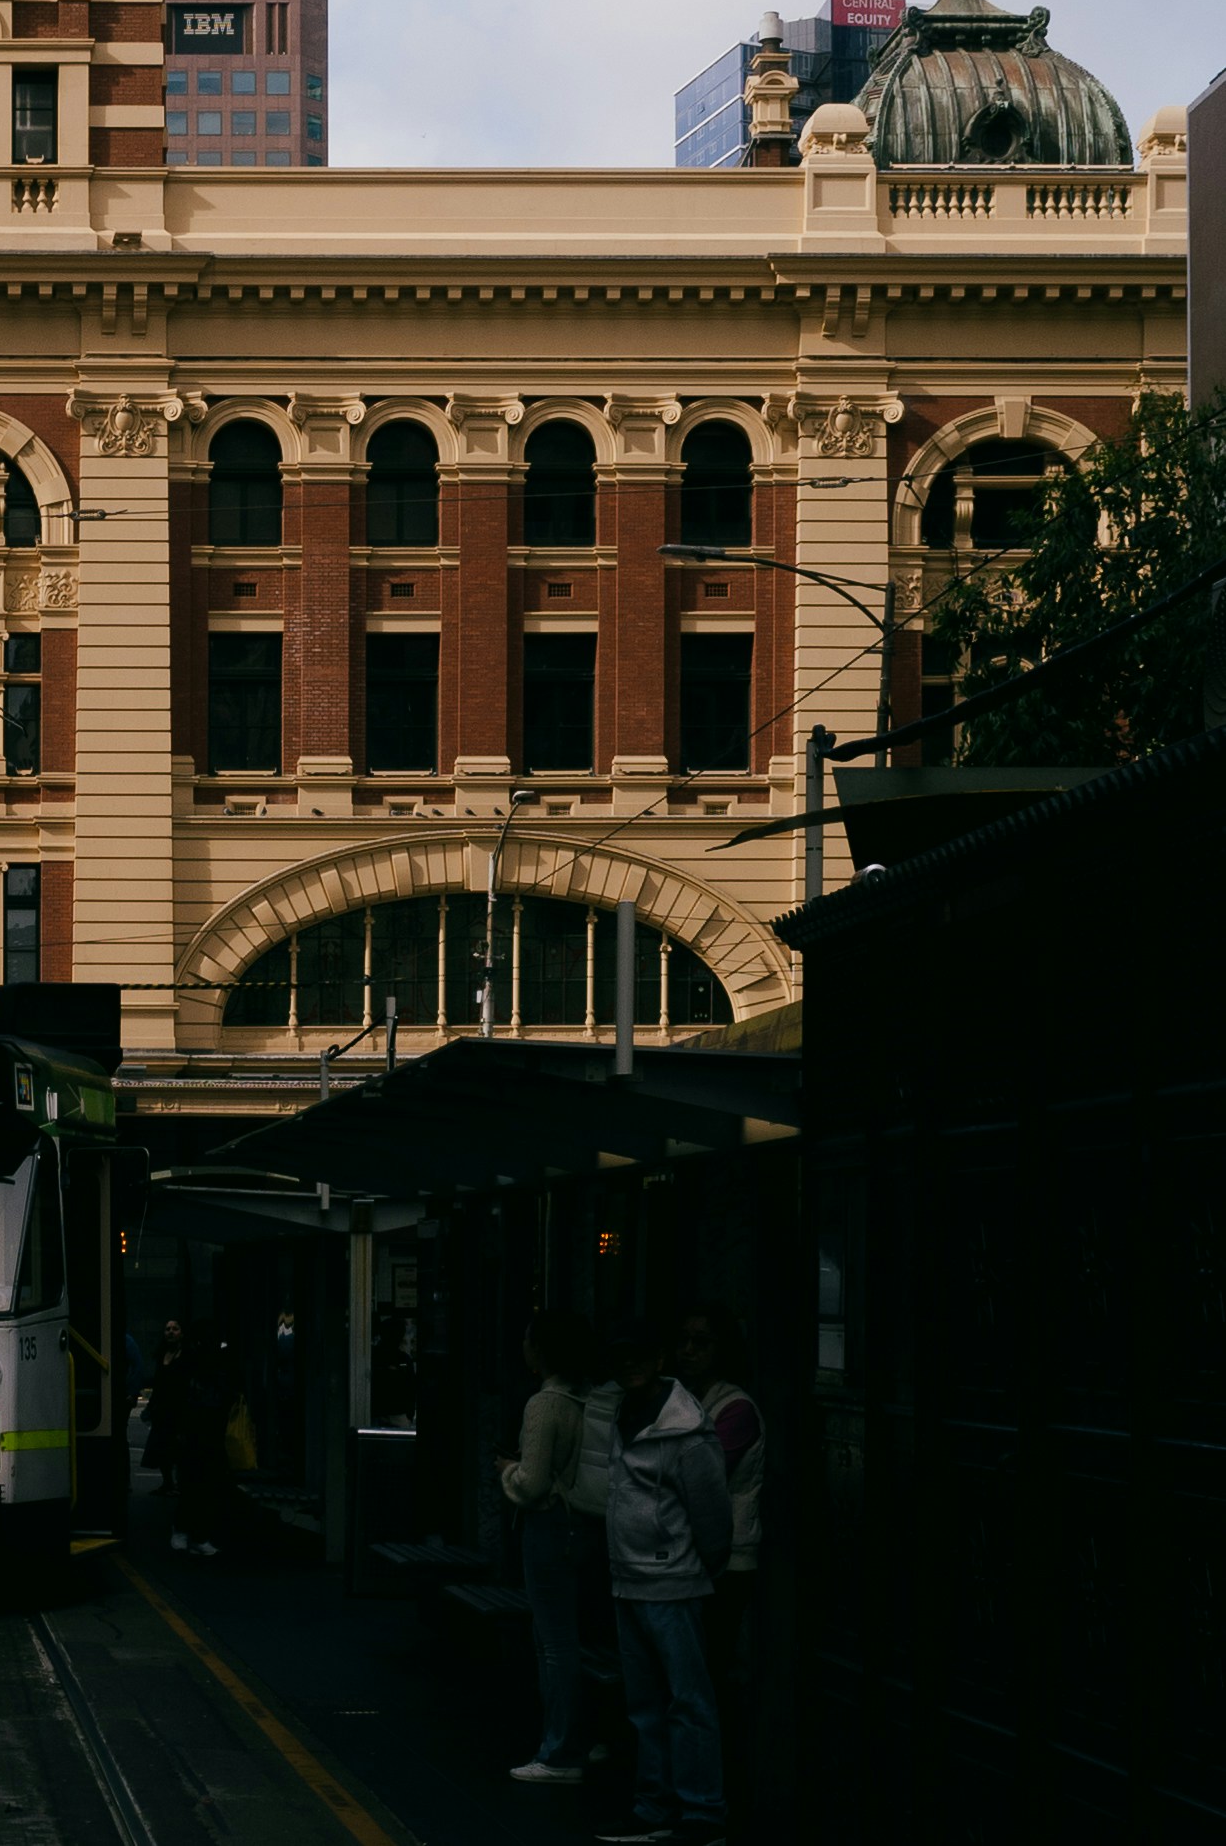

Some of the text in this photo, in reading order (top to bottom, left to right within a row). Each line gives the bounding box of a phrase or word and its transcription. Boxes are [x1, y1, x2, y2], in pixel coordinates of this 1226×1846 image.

[183, 13, 235, 35] IBM
[847, 12, 892, 26] EQUITY
[19, 1336, 38, 1362] 135
